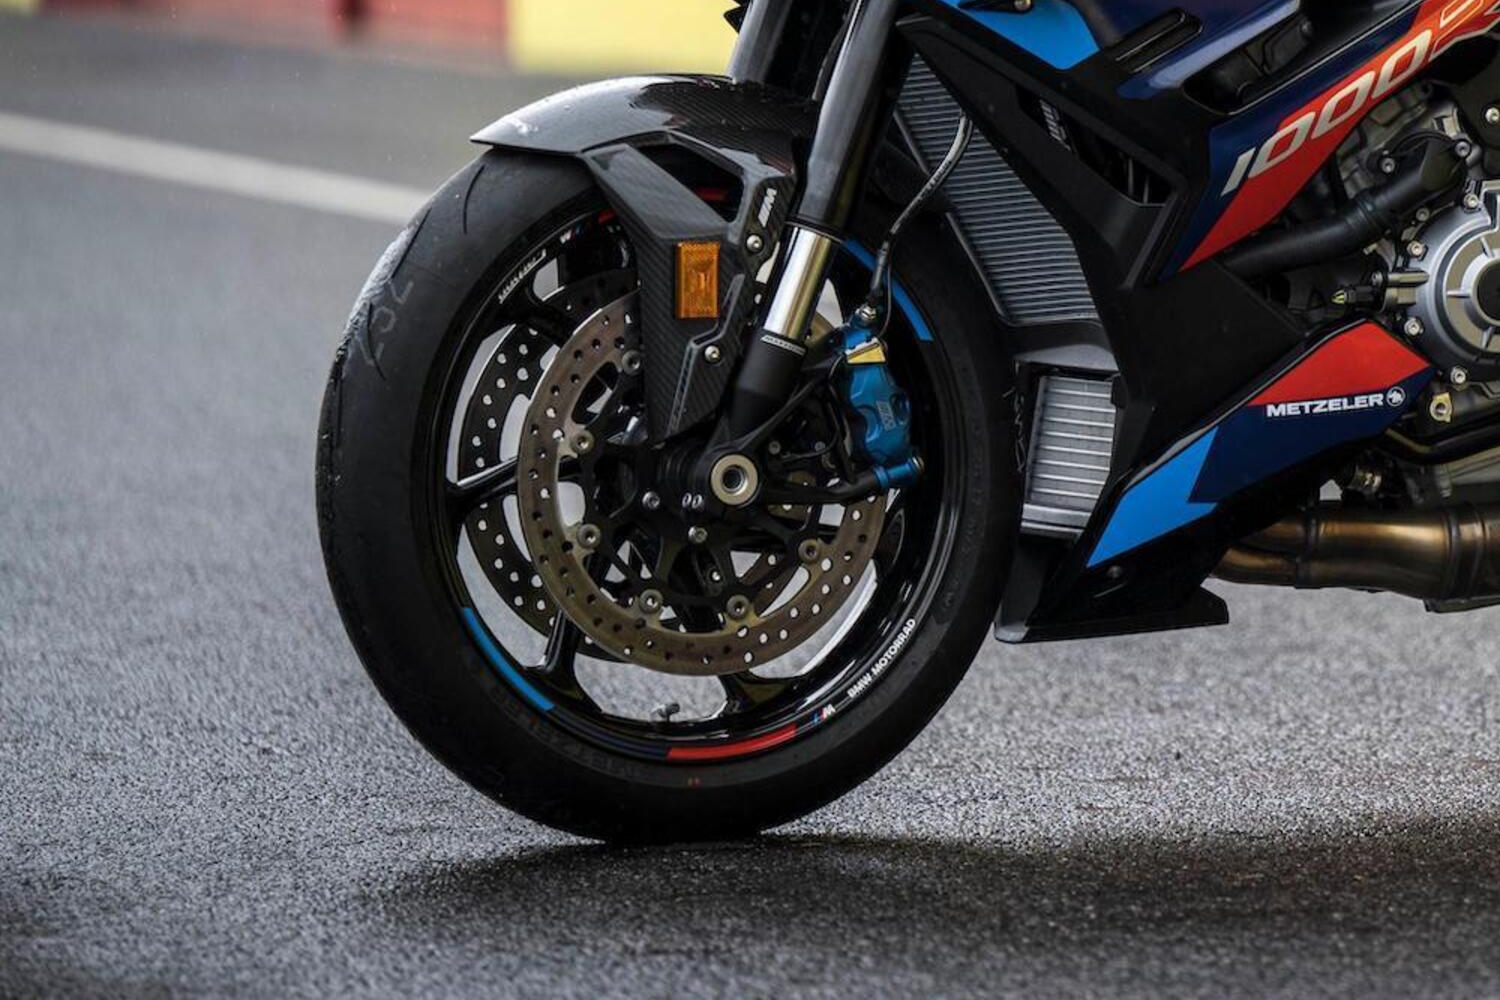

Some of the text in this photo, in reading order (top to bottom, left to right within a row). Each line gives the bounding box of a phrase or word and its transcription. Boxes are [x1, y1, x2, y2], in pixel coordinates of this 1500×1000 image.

[1220, 28, 1433, 198] 1000
[1266, 393, 1384, 418] METZELER
[846, 672, 872, 698] BMW
[870, 618, 916, 676] MOTORRAD
